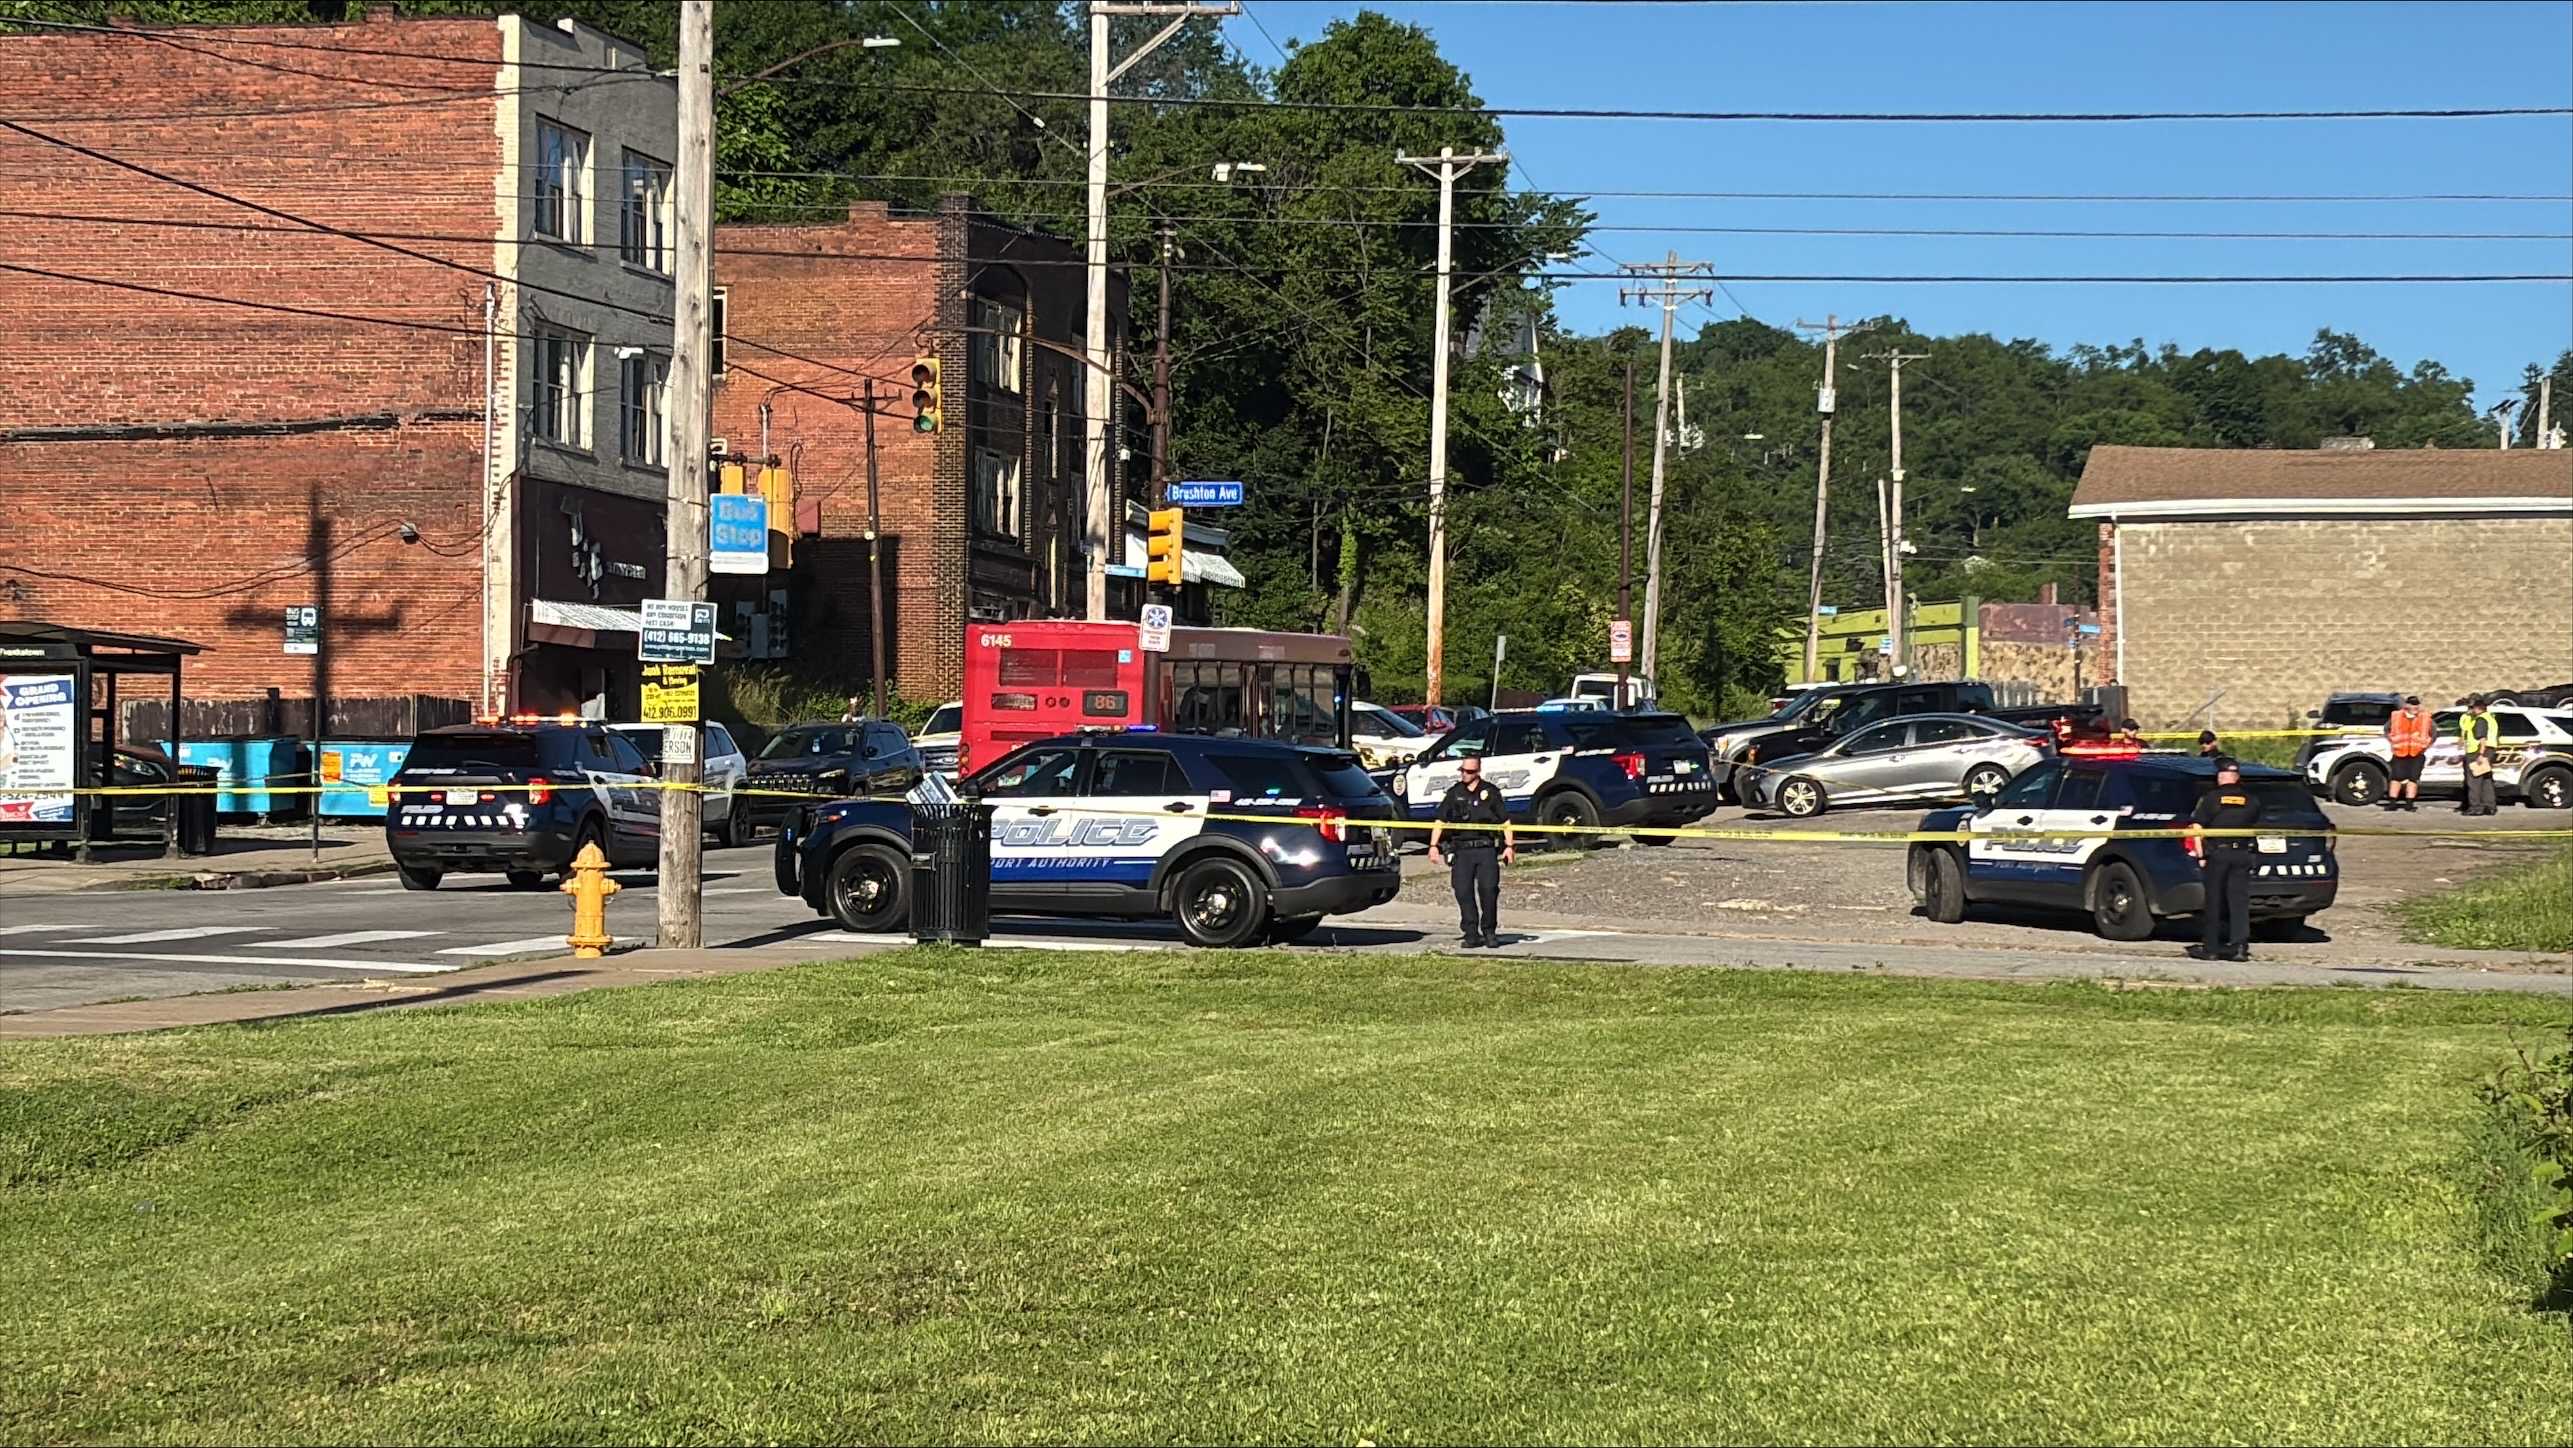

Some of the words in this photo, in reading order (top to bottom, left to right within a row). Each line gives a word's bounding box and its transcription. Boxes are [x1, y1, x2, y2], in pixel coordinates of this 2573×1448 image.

[1172, 486, 1216, 500] Brushton
[1219, 487, 1238, 500] Ave
[719, 501, 758, 520] Bus
[715, 524, 763, 547] Stop
[644, 630, 667, 643] (412)
[981, 634, 1012, 647] 6145
[641, 664, 661, 676] Junk
[662, 664, 696, 676] Removal
[19, 683, 59, 697] GRAND
[15, 692, 67, 707] OPENING
[1094, 695, 1116, 710] 86
[1028, 857, 1111, 869] AUTHORITY
